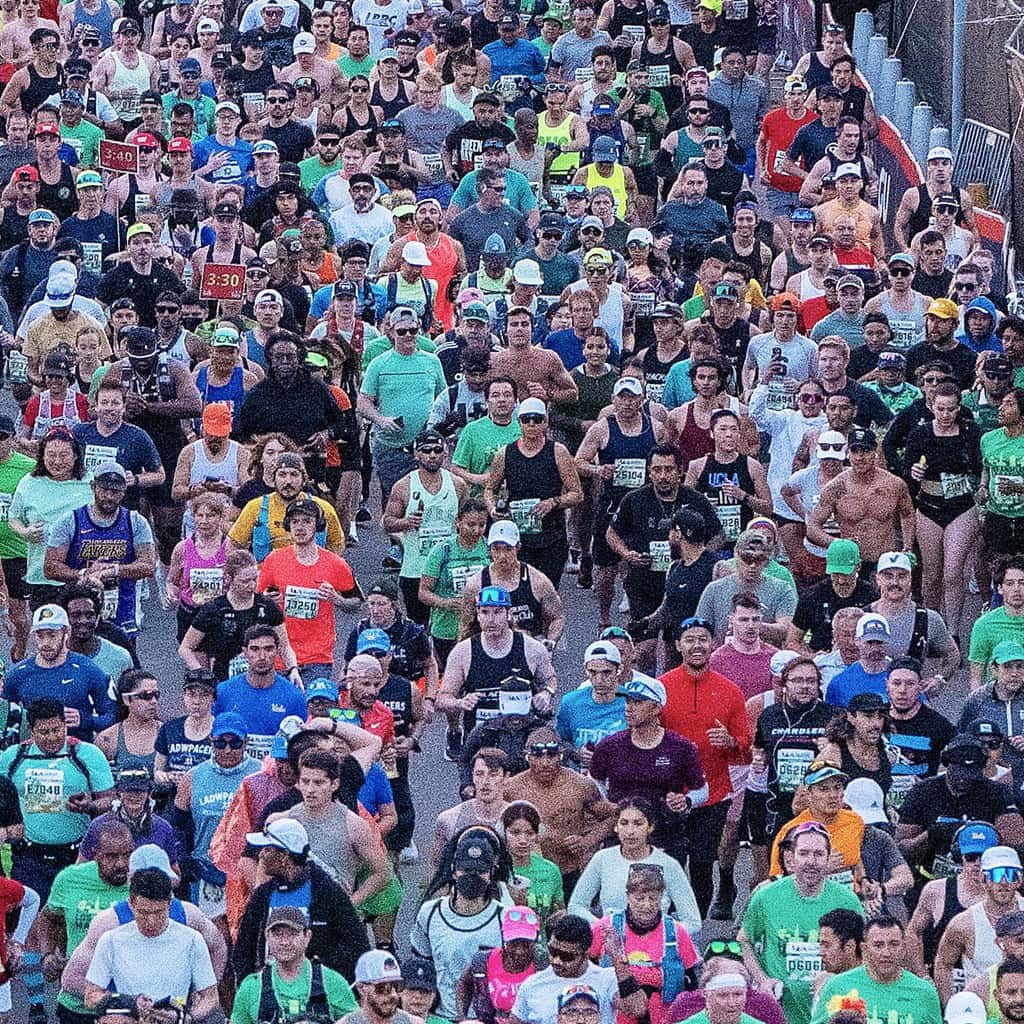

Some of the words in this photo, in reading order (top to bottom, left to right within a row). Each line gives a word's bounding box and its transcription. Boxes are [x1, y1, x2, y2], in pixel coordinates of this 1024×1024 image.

[104, 148, 132, 161] 3:40
[207, 273, 240, 287] 3:30
[771, 727, 825, 735] CHANDLER
